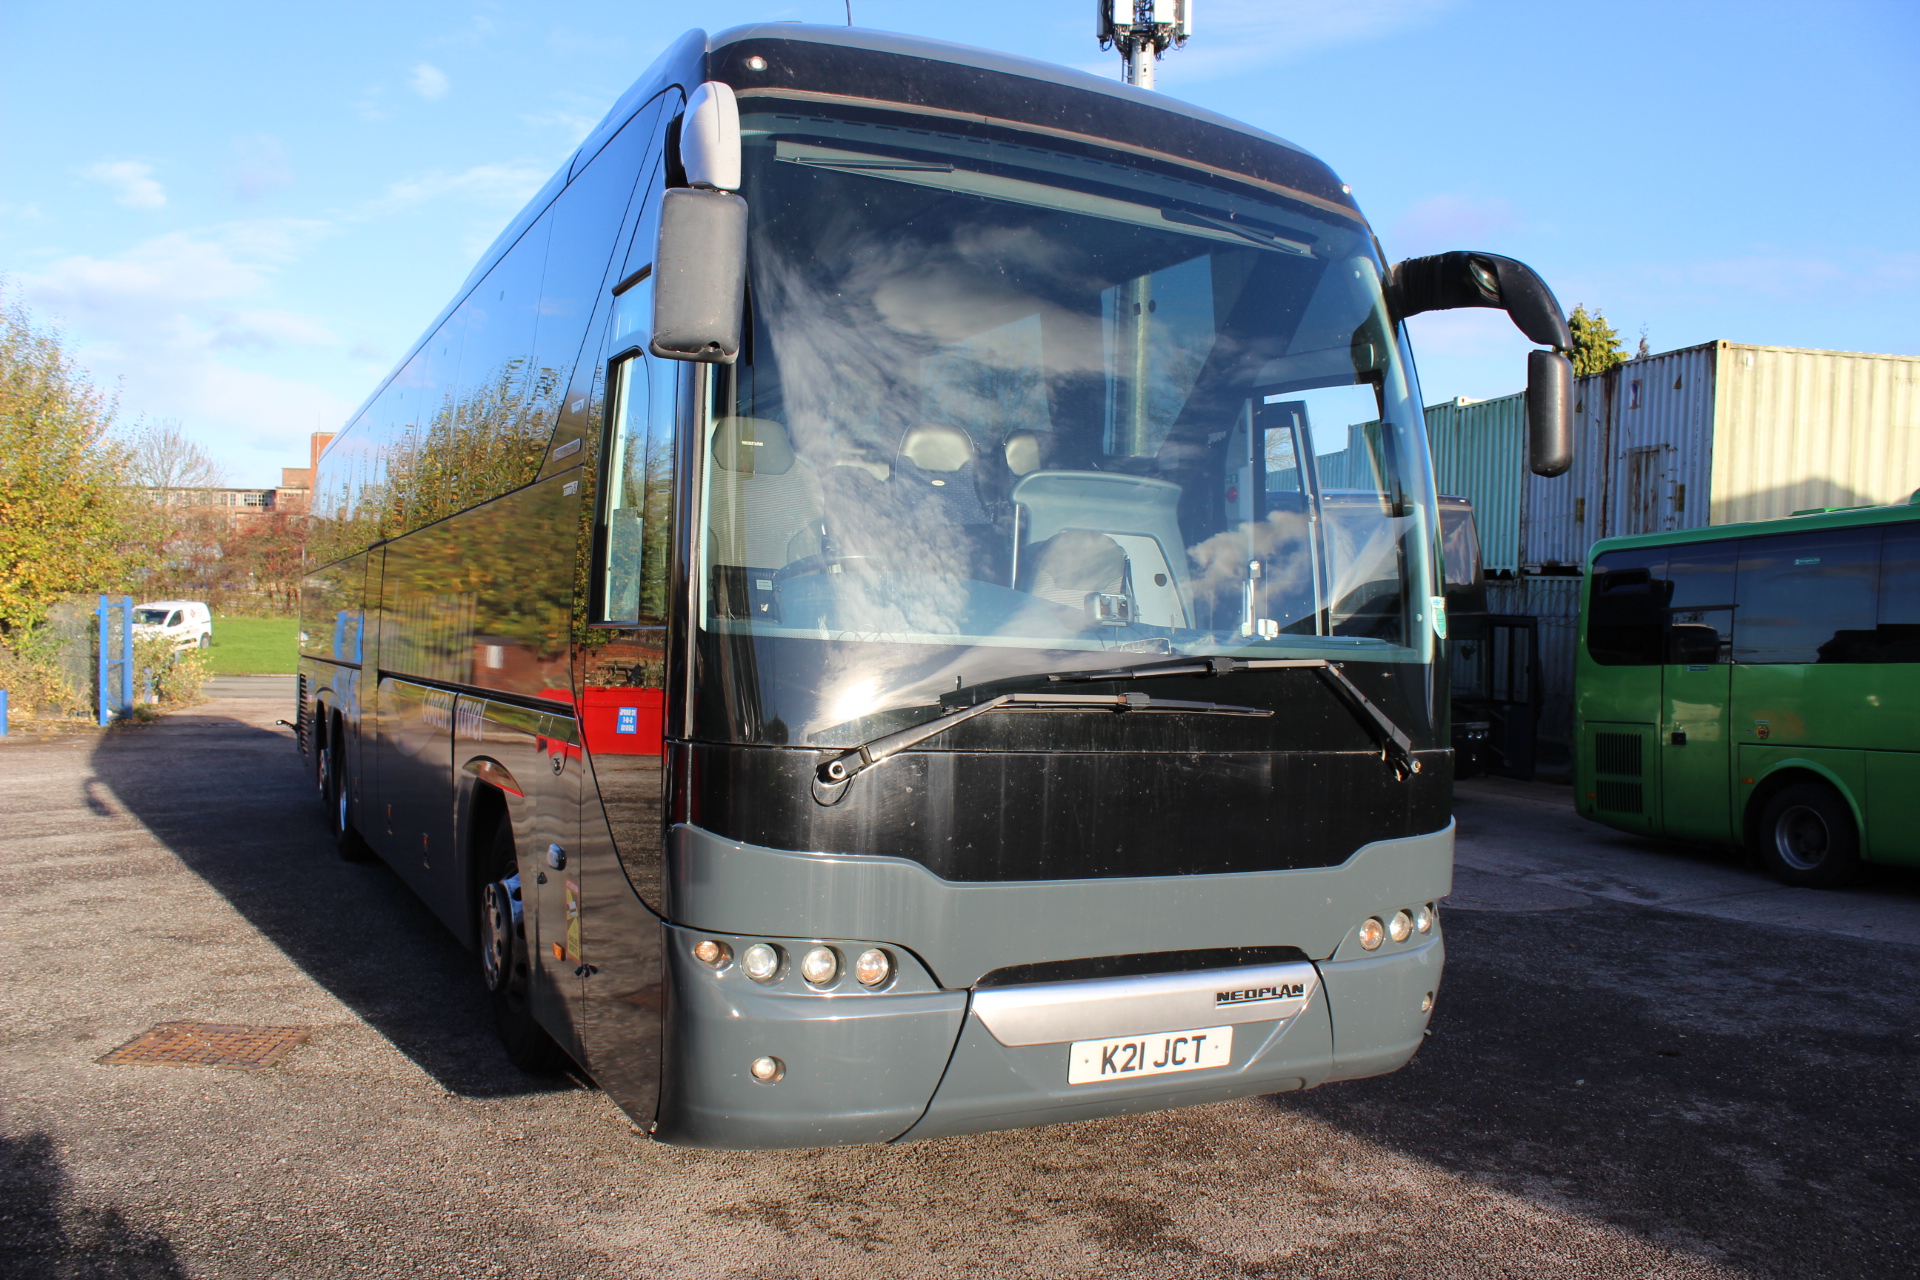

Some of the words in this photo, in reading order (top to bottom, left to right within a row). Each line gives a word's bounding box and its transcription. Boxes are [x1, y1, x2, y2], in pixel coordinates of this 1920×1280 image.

[1216, 983, 1304, 1003] NEOPLAN
[1101, 1041, 1146, 1075] K21
[1152, 1034, 1207, 1068] JCT
